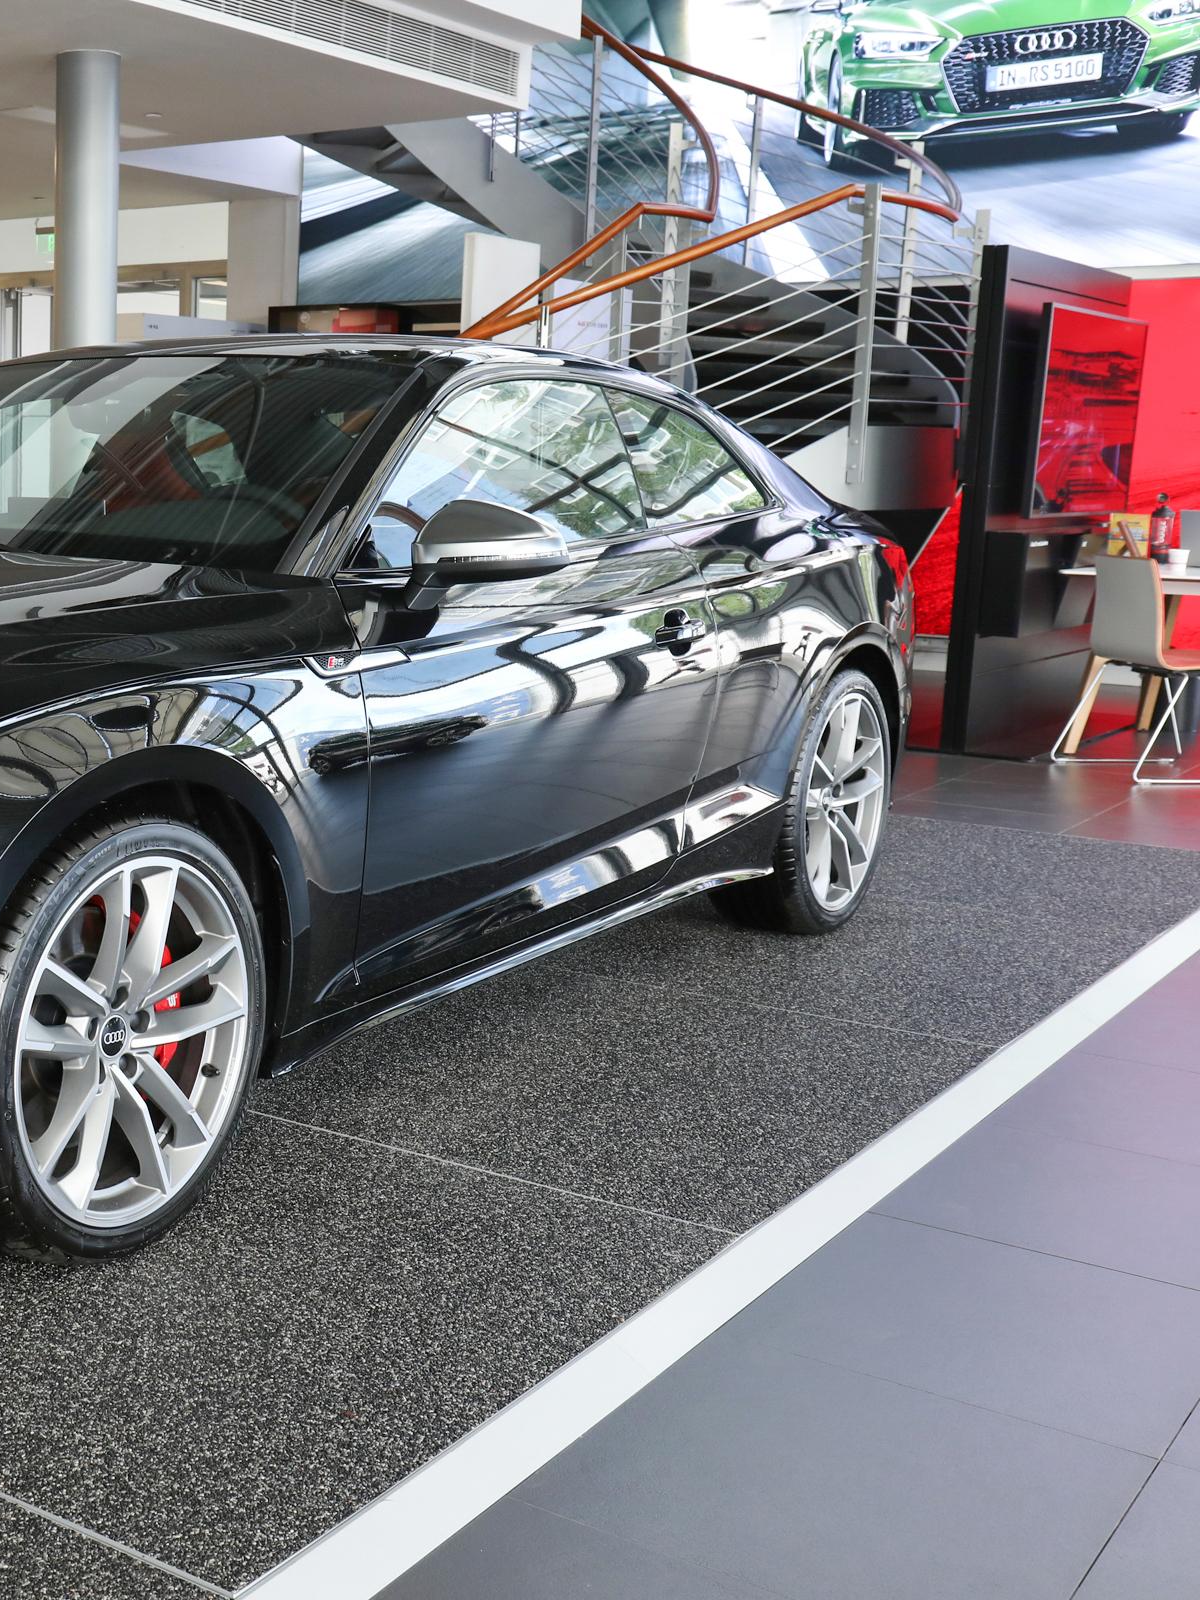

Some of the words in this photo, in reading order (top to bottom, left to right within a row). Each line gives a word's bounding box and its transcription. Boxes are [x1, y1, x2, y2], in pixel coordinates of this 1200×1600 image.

[1000, 70, 1016, 86] IN
[1030, 64, 1050, 83] RS
[1053, 58, 1096, 80] 5100
